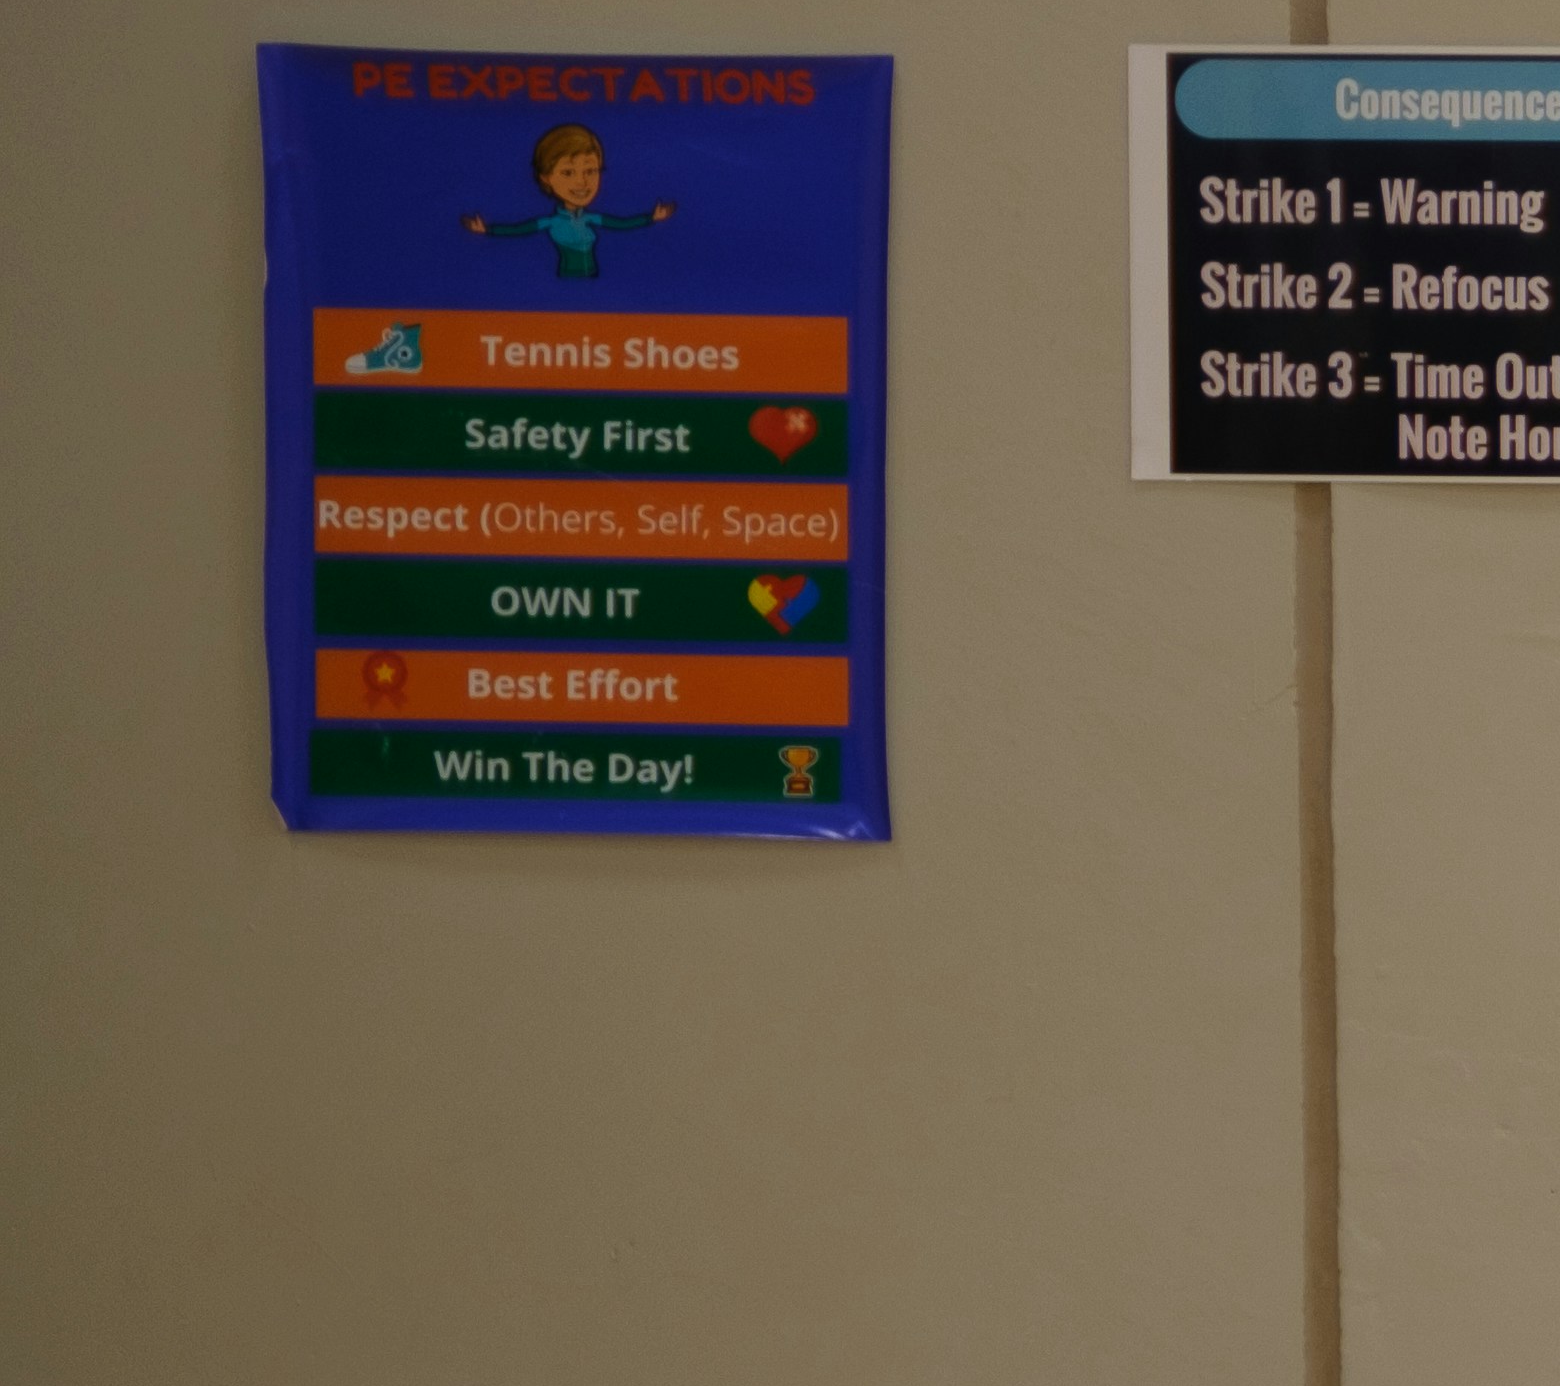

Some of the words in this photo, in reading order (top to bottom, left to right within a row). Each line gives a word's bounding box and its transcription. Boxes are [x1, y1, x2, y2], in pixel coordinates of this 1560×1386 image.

[353, 62, 413, 99] PE
[430, 64, 816, 106] EXPECTATIONS
[1199, 176, 1316, 223] Strike
[1326, 179, 1342, 223] 1
[1353, 201, 1370, 218] =
[1380, 179, 1546, 234] Warning
[1200, 262, 1317, 309] Strike
[1328, 263, 1353, 309] 2
[1363, 286, 1380, 303] =
[1392, 263, 1549, 311] Refocus
[481, 334, 611, 369] Tennis
[623, 338, 739, 371] Shoes
[1200, 350, 1317, 397] Strike
[1328, 351, 1353, 398] 3
[1363, 375, 1380, 392] =
[1391, 353, 1484, 399] Time
[465, 418, 591, 459] Safety
[603, 421, 691, 454] First
[1398, 415, 1488, 460] Note
[319, 502, 469, 541] Respect
[480, 500, 625, 539] (Others,
[637, 503, 713, 541] Self,
[723, 506, 839, 544] Space)
[491, 586, 591, 618] OWN
[605, 589, 639, 618] IT
[468, 670, 555, 701] Best
[566, 670, 678, 704] Effort
[435, 750, 510, 781] Win
[523, 752, 595, 783] The
[608, 754, 694, 792] Day!
